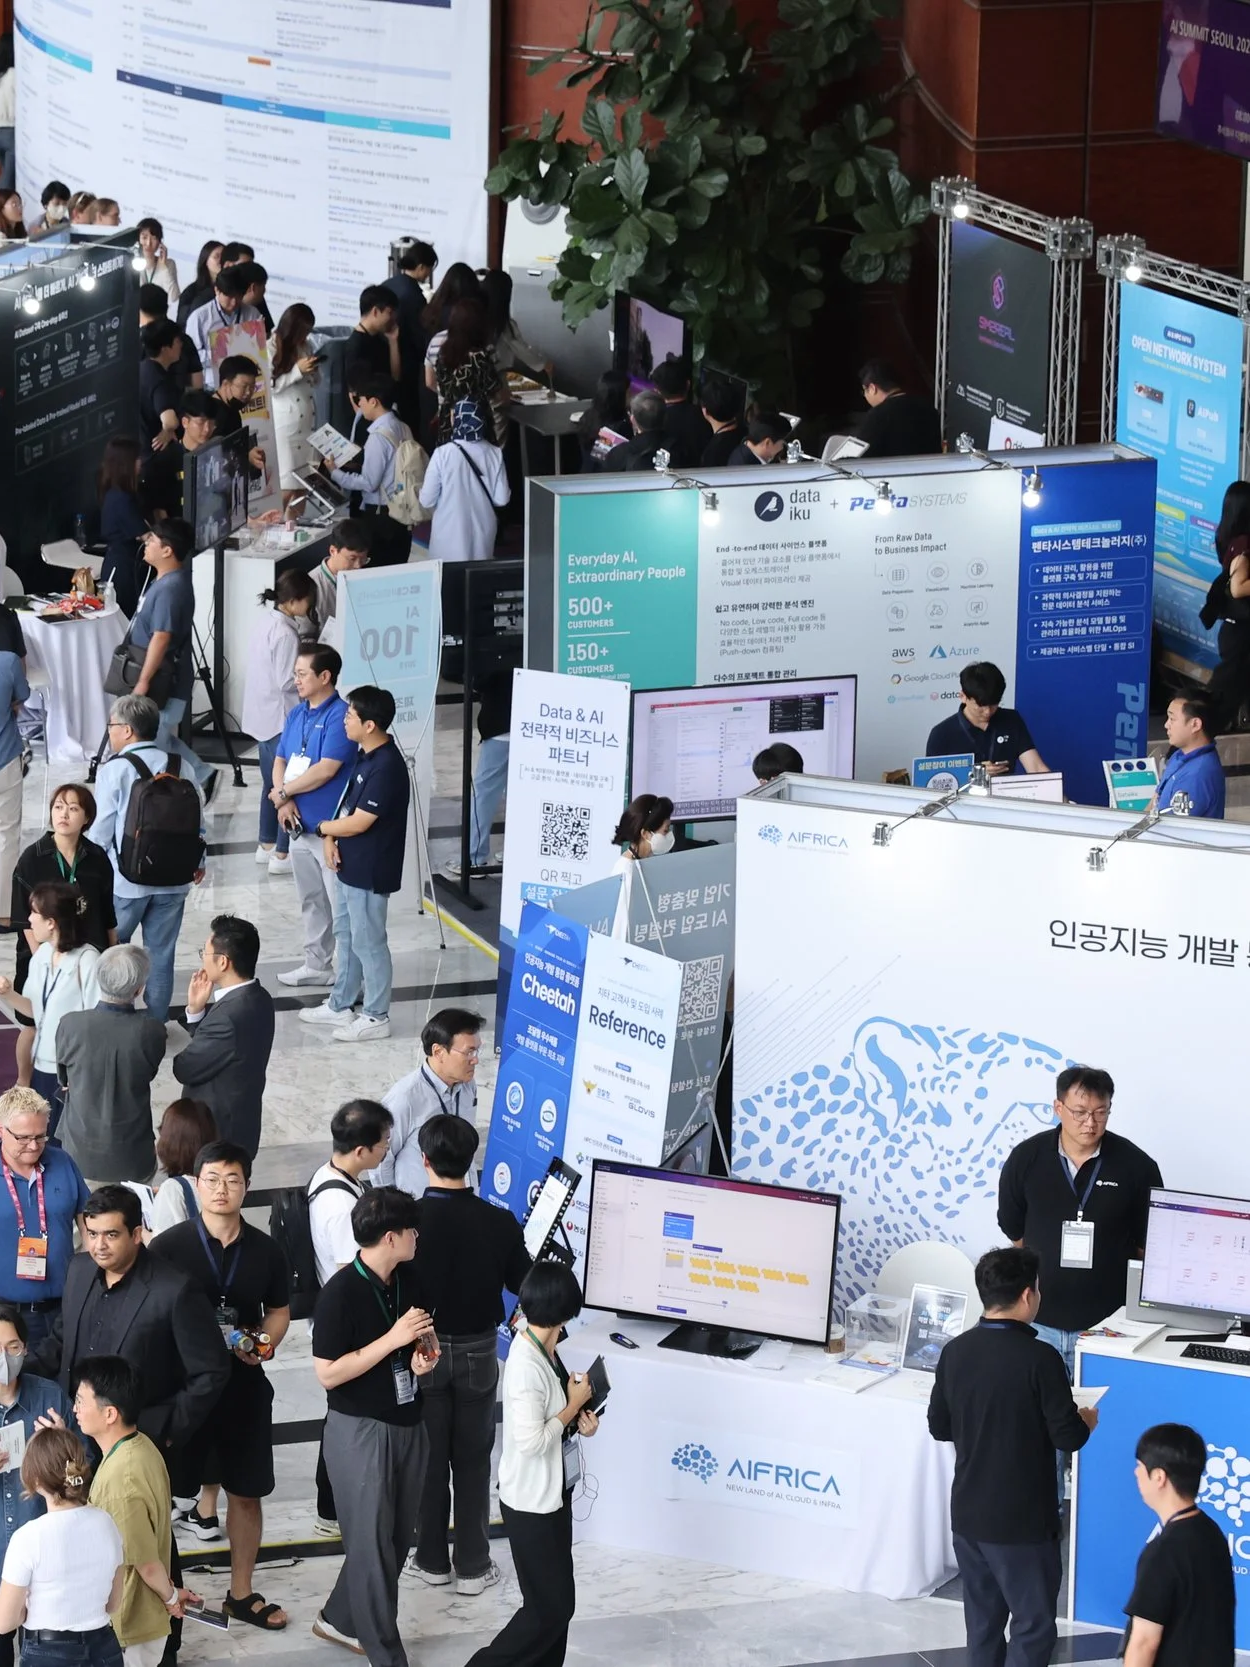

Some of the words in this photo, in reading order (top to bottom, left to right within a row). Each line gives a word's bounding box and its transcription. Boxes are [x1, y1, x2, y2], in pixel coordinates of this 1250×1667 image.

[1170, 19, 1177, 34] AI
[1179, 21, 1209, 42] SUMMIT
[1211, 29, 1234, 50] SEOUL
[1132, 335, 1152, 353] OPEN
[1152, 341, 1191, 368] NETWORK
[1191, 354, 1227, 379] SYSTEM
[789, 506, 811, 521] iku
[875, 535, 894, 543] From
[896, 534, 912, 542] Raw
[914, 532, 932, 541] Data
[1032, 535, 1147, 553] 펜타시스템테크놀러지(주)
[875, 547, 882, 555] to
[884, 545, 919, 554] Business
[920, 543, 947, 553] Impact
[567, 553, 619, 567] Everyday
[621, 551, 638, 565] AI,
[567, 567, 645, 584] Extraordinary
[647, 565, 686, 580] People
[1042, 565, 1062, 573] 데이터
[568, 597, 613, 616] 500+
[567, 618, 614, 629] CUSTOMERS
[567, 643, 609, 662] 150+
[891, 647, 915, 658] aws
[949, 646, 980, 656] Azure
[567, 664, 614, 675] CUSTOMERS
[713, 670, 736, 682] 다수의
[737, 669, 766, 681] 프로젝트
[766, 668, 782, 680] 통합
[783, 668, 797, 678] 관리
[903, 674, 929, 683] Google
[930, 671, 950, 680] Cloud
[539, 703, 573, 721] Data
[576, 706, 586, 721] &
[589, 708, 604, 724] AI
[520, 721, 561, 743] 전략적
[565, 726, 620, 749] 비즈니스
[548, 747, 589, 767] 파트너
[787, 831, 848, 849] AIFRICA
[540, 869, 558, 883] QR
[560, 870, 583, 886] 찍고
[525, 884, 549, 901] 설문
[1049, 919, 1168, 960] 인공지능
[1178, 933, 1239, 968] 개발
[521, 972, 576, 1016] Cheetah
[589, 1004, 667, 1050] Reference
[628, 1102, 656, 1119] GLOVIS
[727, 1458, 841, 1496] AIFRICA
[726, 1483, 744, 1493] NEW
[745, 1487, 765, 1498] LAND
[766, 1490, 774, 1498] of
[786, 1494, 812, 1505] CLOUD
[819, 1500, 842, 1510] INFRA
